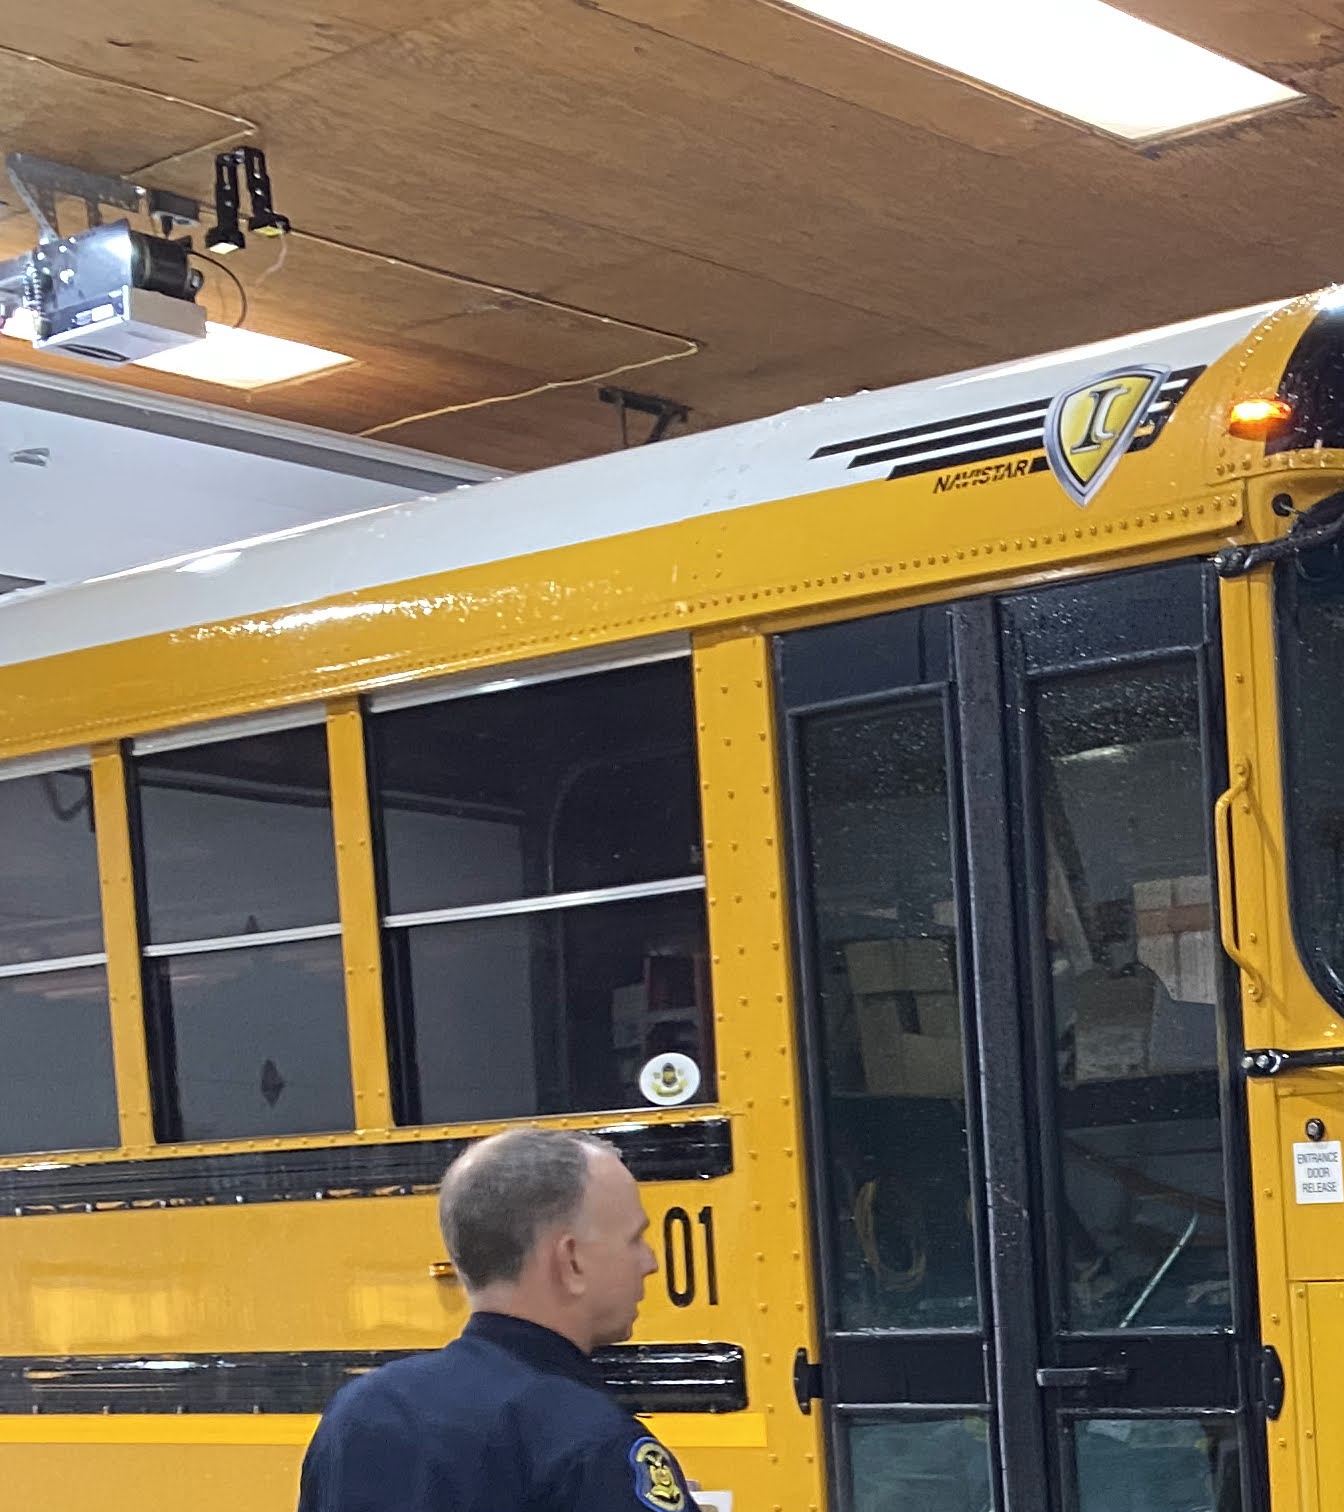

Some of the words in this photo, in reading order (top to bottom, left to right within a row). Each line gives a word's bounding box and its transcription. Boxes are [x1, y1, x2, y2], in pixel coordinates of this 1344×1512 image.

[932, 459, 1030, 494] NAVISTAR
[1297, 1152, 1338, 1164] ENTRANCE
[1306, 1167, 1330, 1179] DOOR
[1303, 1182, 1337, 1193] RELEASE
[663, 1206, 718, 1308] 01
